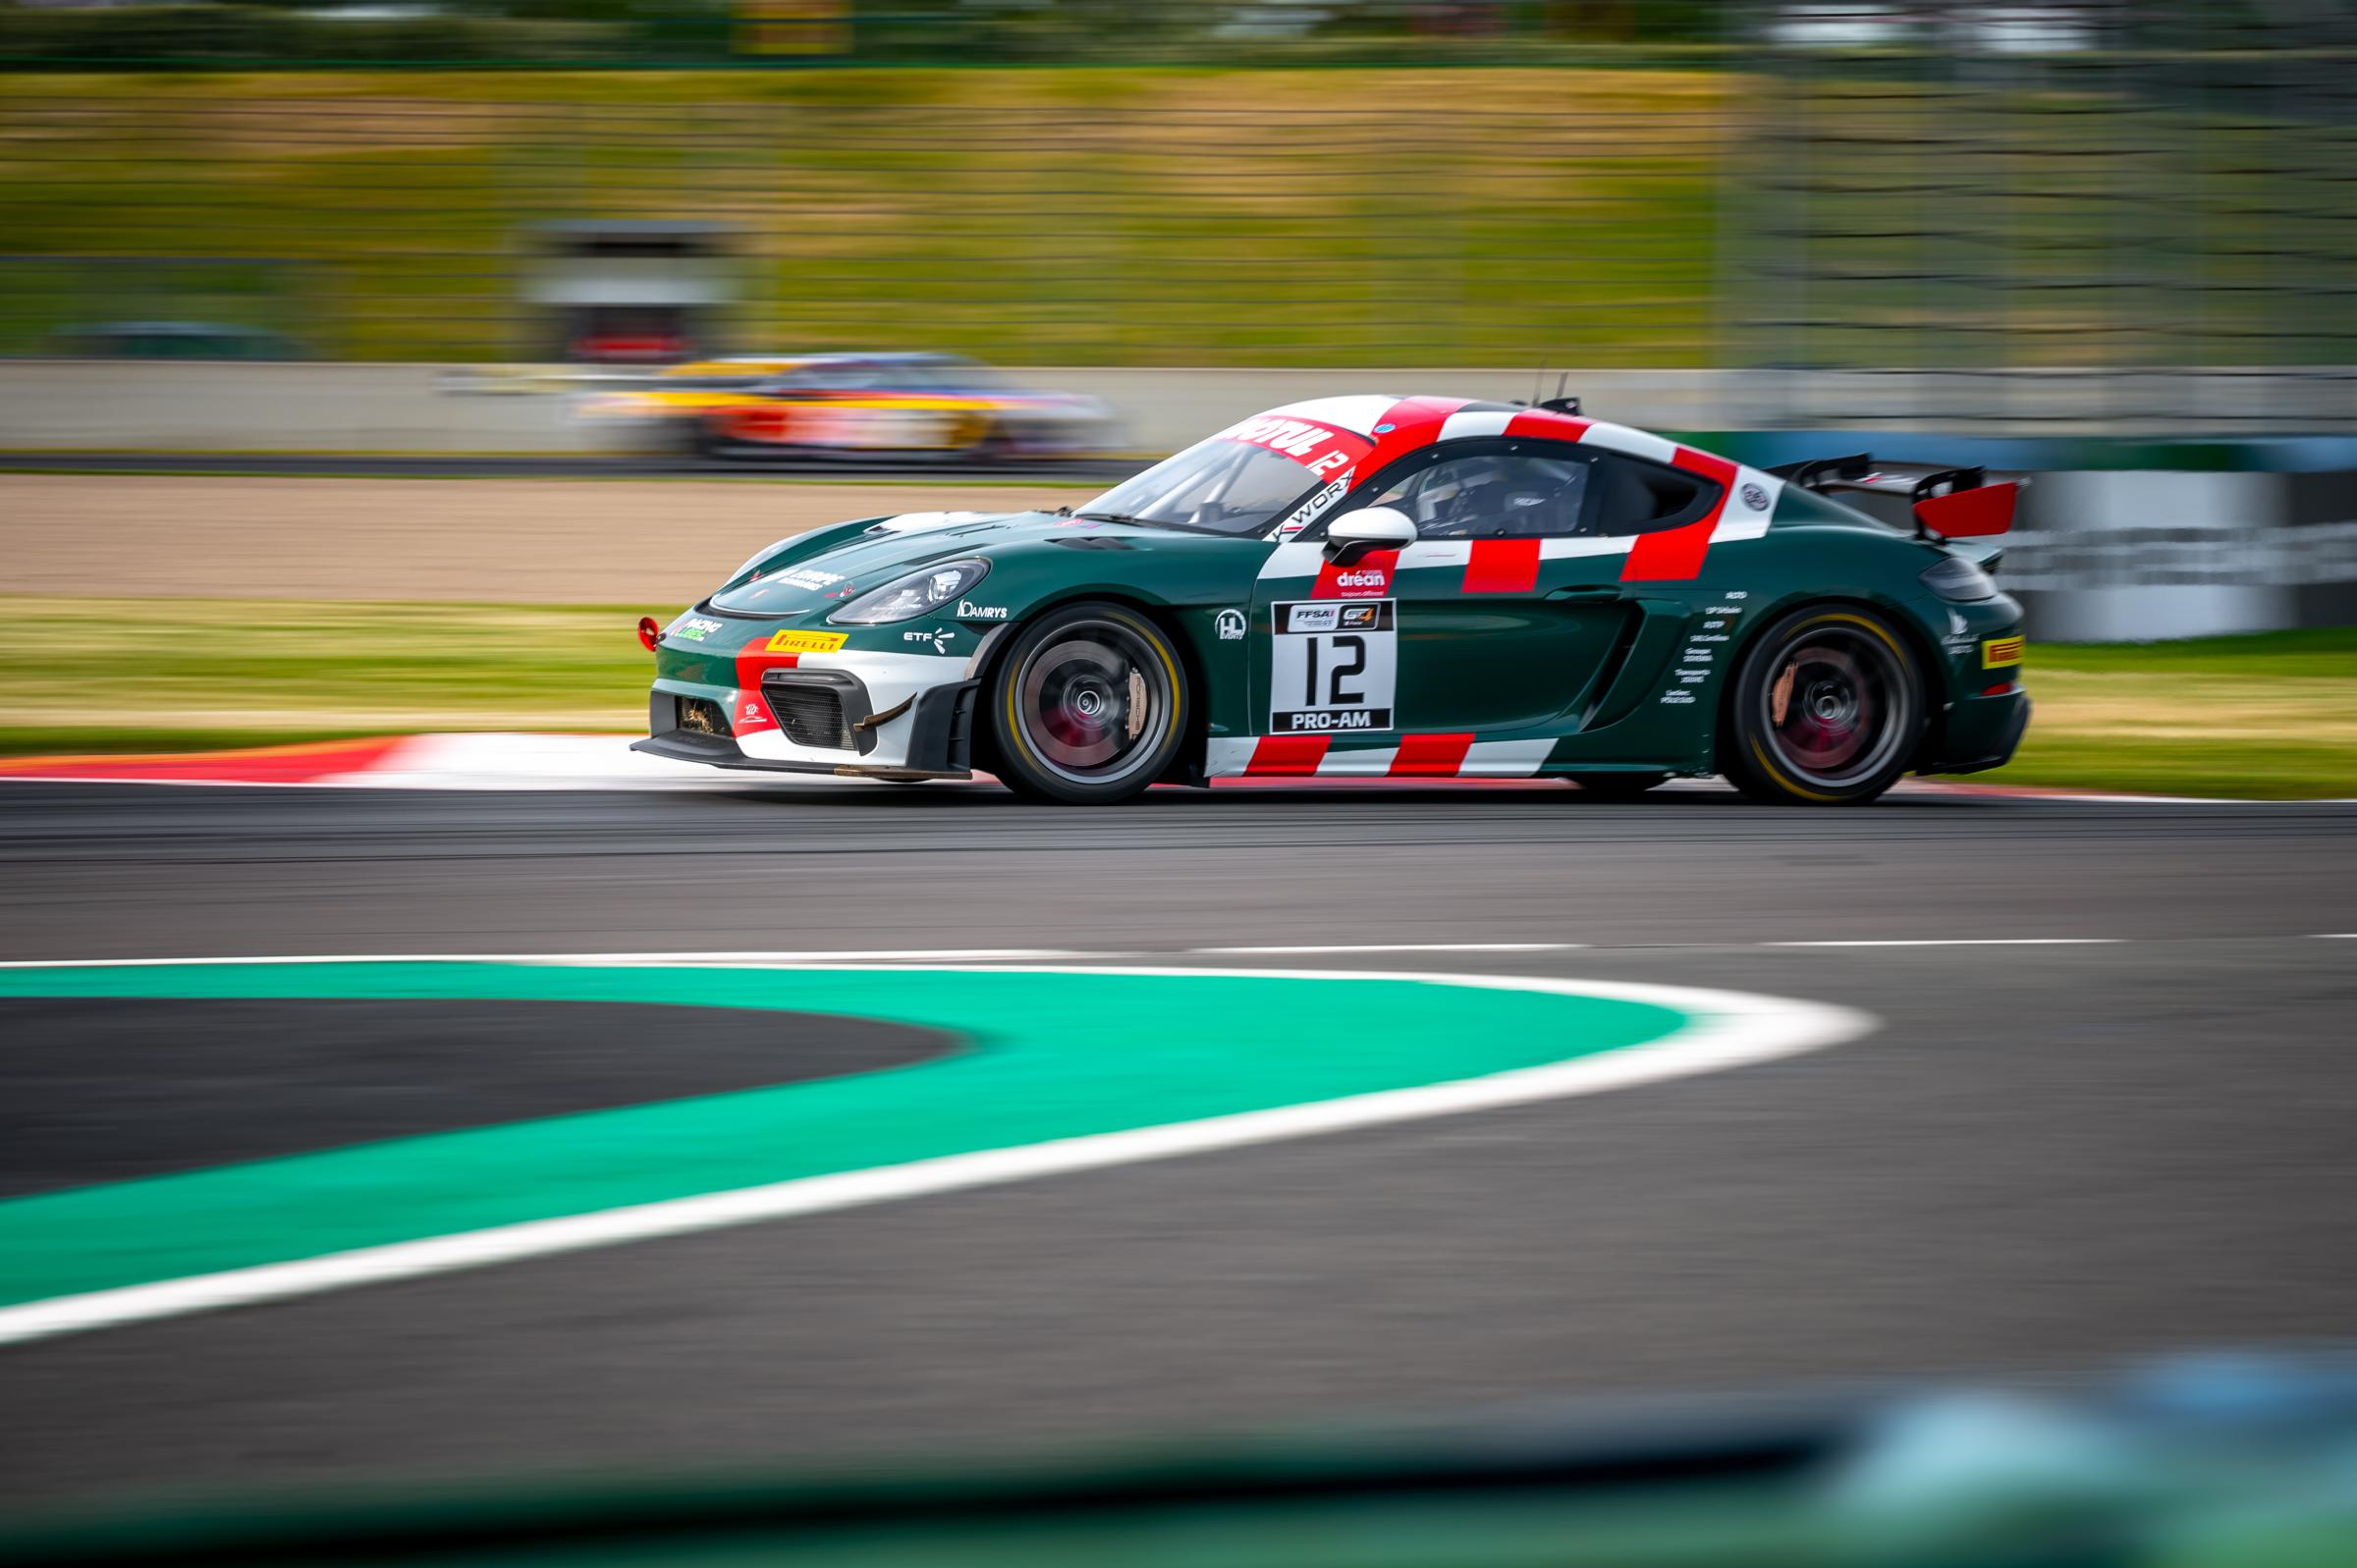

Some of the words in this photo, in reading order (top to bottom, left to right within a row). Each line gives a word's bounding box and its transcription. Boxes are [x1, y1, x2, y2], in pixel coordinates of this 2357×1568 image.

[1305, 450, 1349, 476] 12
[1291, 470, 1357, 523] WORX
[1337, 569, 1385, 587] dréan
[775, 634, 839, 650] PIRELLI
[904, 631, 932, 641] ETF
[1305, 635, 1365, 707] 12
[1291, 711, 1371, 730] PRO-AM
